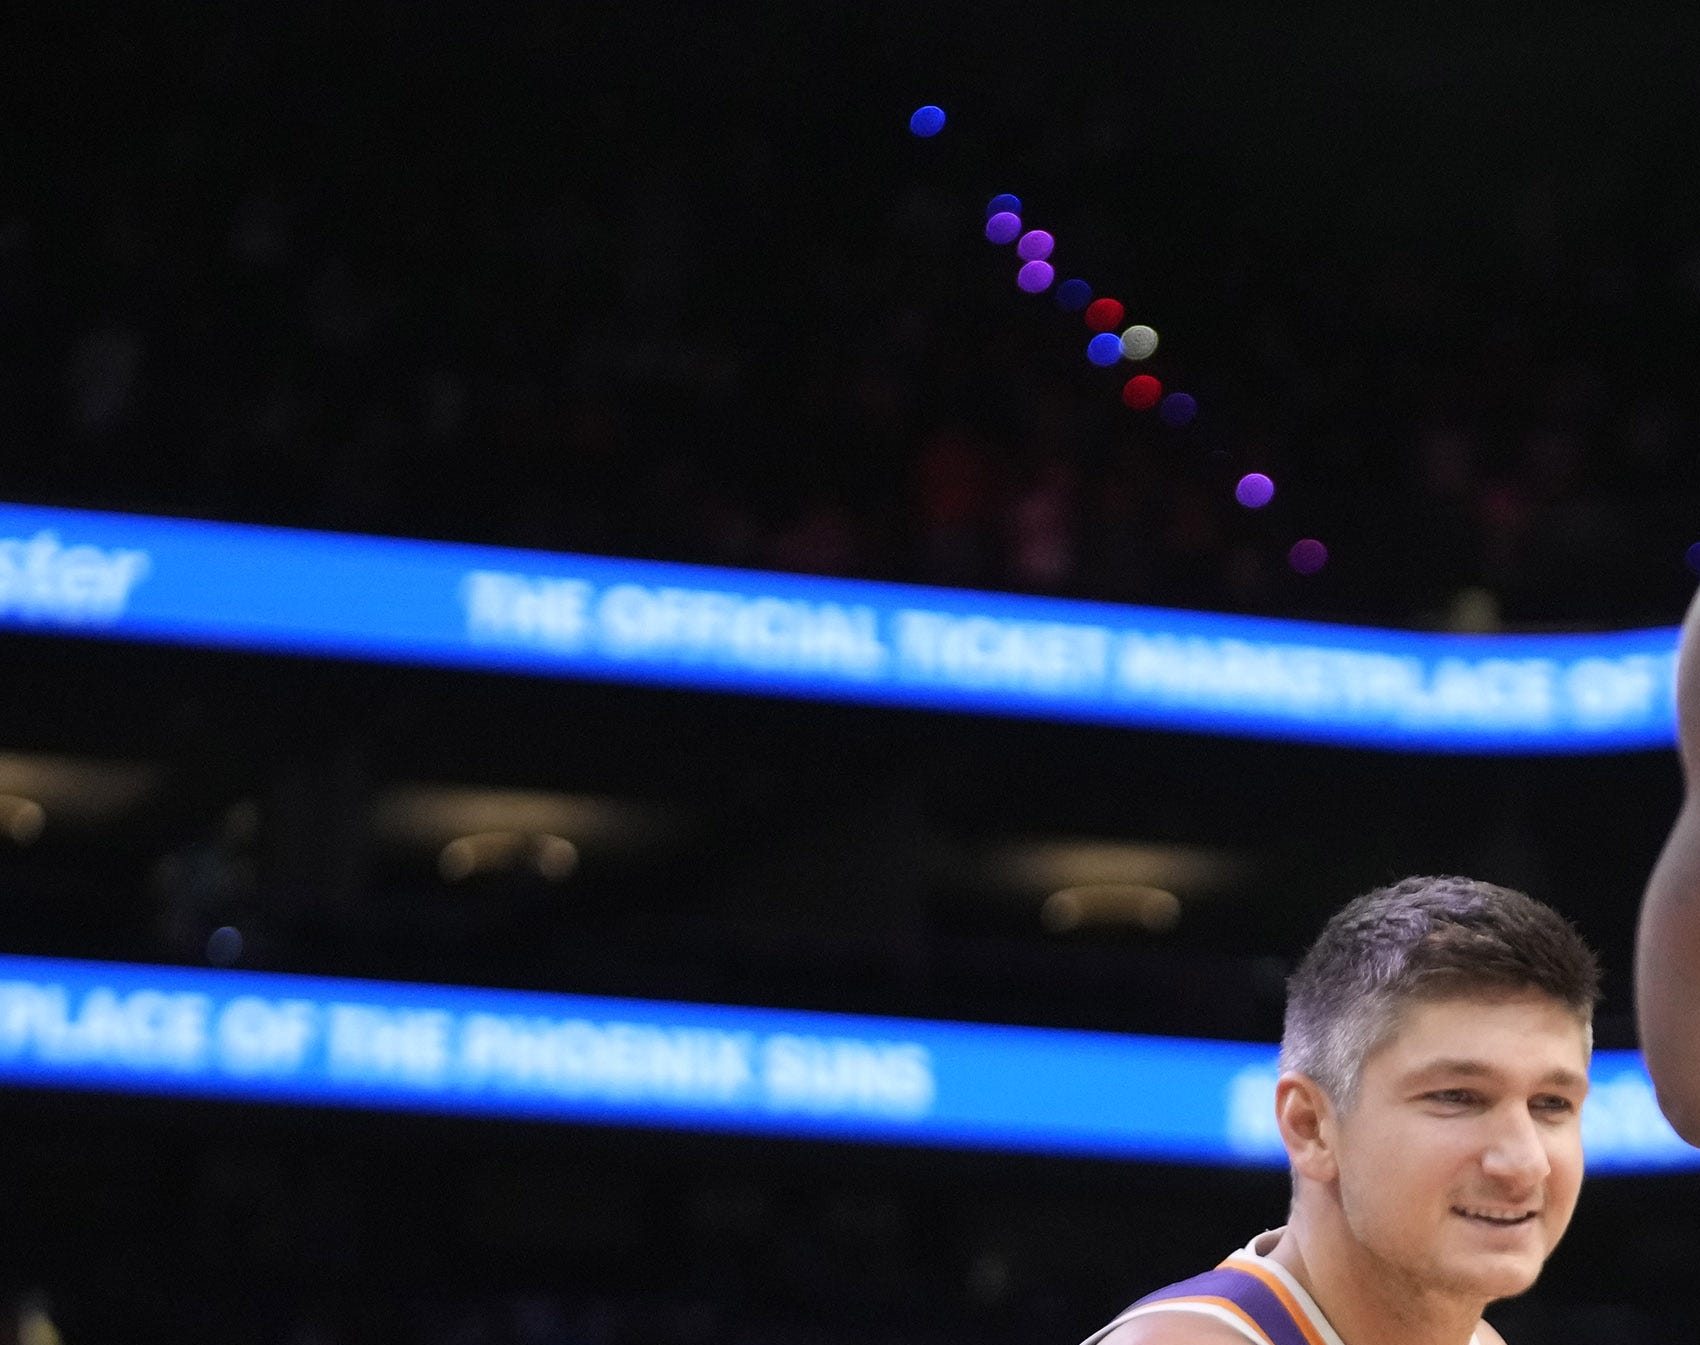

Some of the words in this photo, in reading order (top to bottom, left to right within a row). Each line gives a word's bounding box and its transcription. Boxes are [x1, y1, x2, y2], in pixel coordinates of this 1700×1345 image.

[466, 569, 593, 658] THE
[600, 582, 886, 683] OFFICIAL
[896, 608, 1106, 700] TICKET
[1118, 629, 1552, 734] MARKETPLACE
[217, 995, 314, 1080] OF
[328, 1000, 449, 1090] THE
[461, 1012, 753, 1107] PHOENIX
[762, 1031, 936, 1122] SUNS
